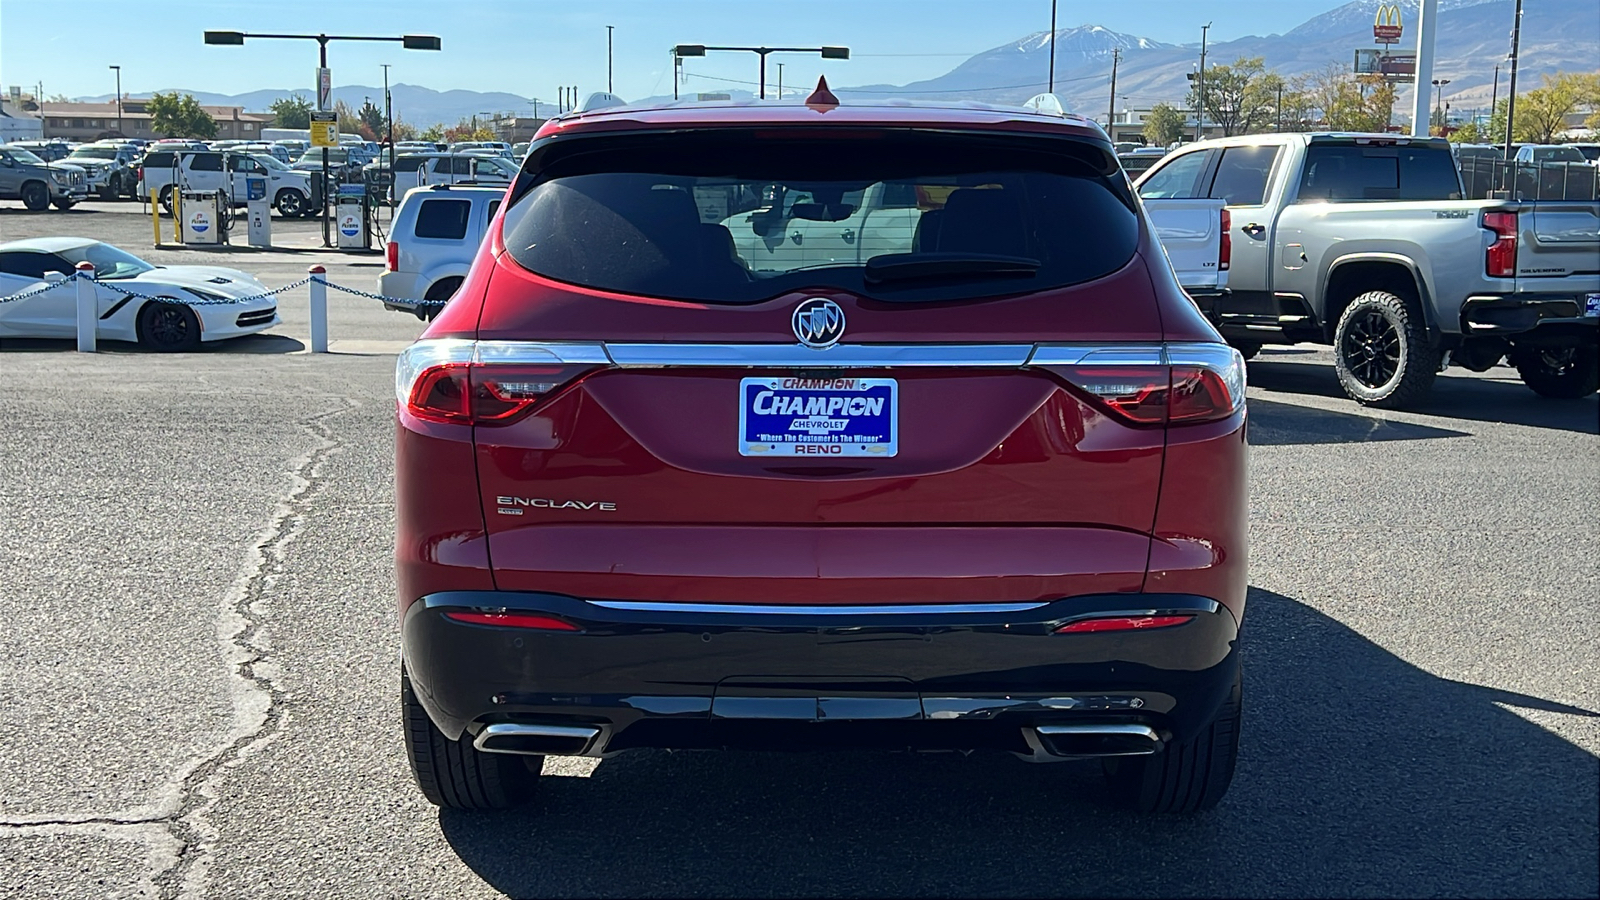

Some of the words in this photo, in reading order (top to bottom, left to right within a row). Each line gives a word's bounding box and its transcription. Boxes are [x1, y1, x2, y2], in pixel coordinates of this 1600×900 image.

[783, 378, 855, 389] CHAMPION
[752, 390, 884, 416] CHAMPION
[793, 420, 845, 429] CHEVROLET
[784, 433, 796, 442] The
[798, 433, 831, 442] Customer
[831, 434, 838, 442] Is
[840, 434, 853, 442] The
[795, 444, 842, 454] RENO
[496, 495, 617, 511] ENCLAVE
